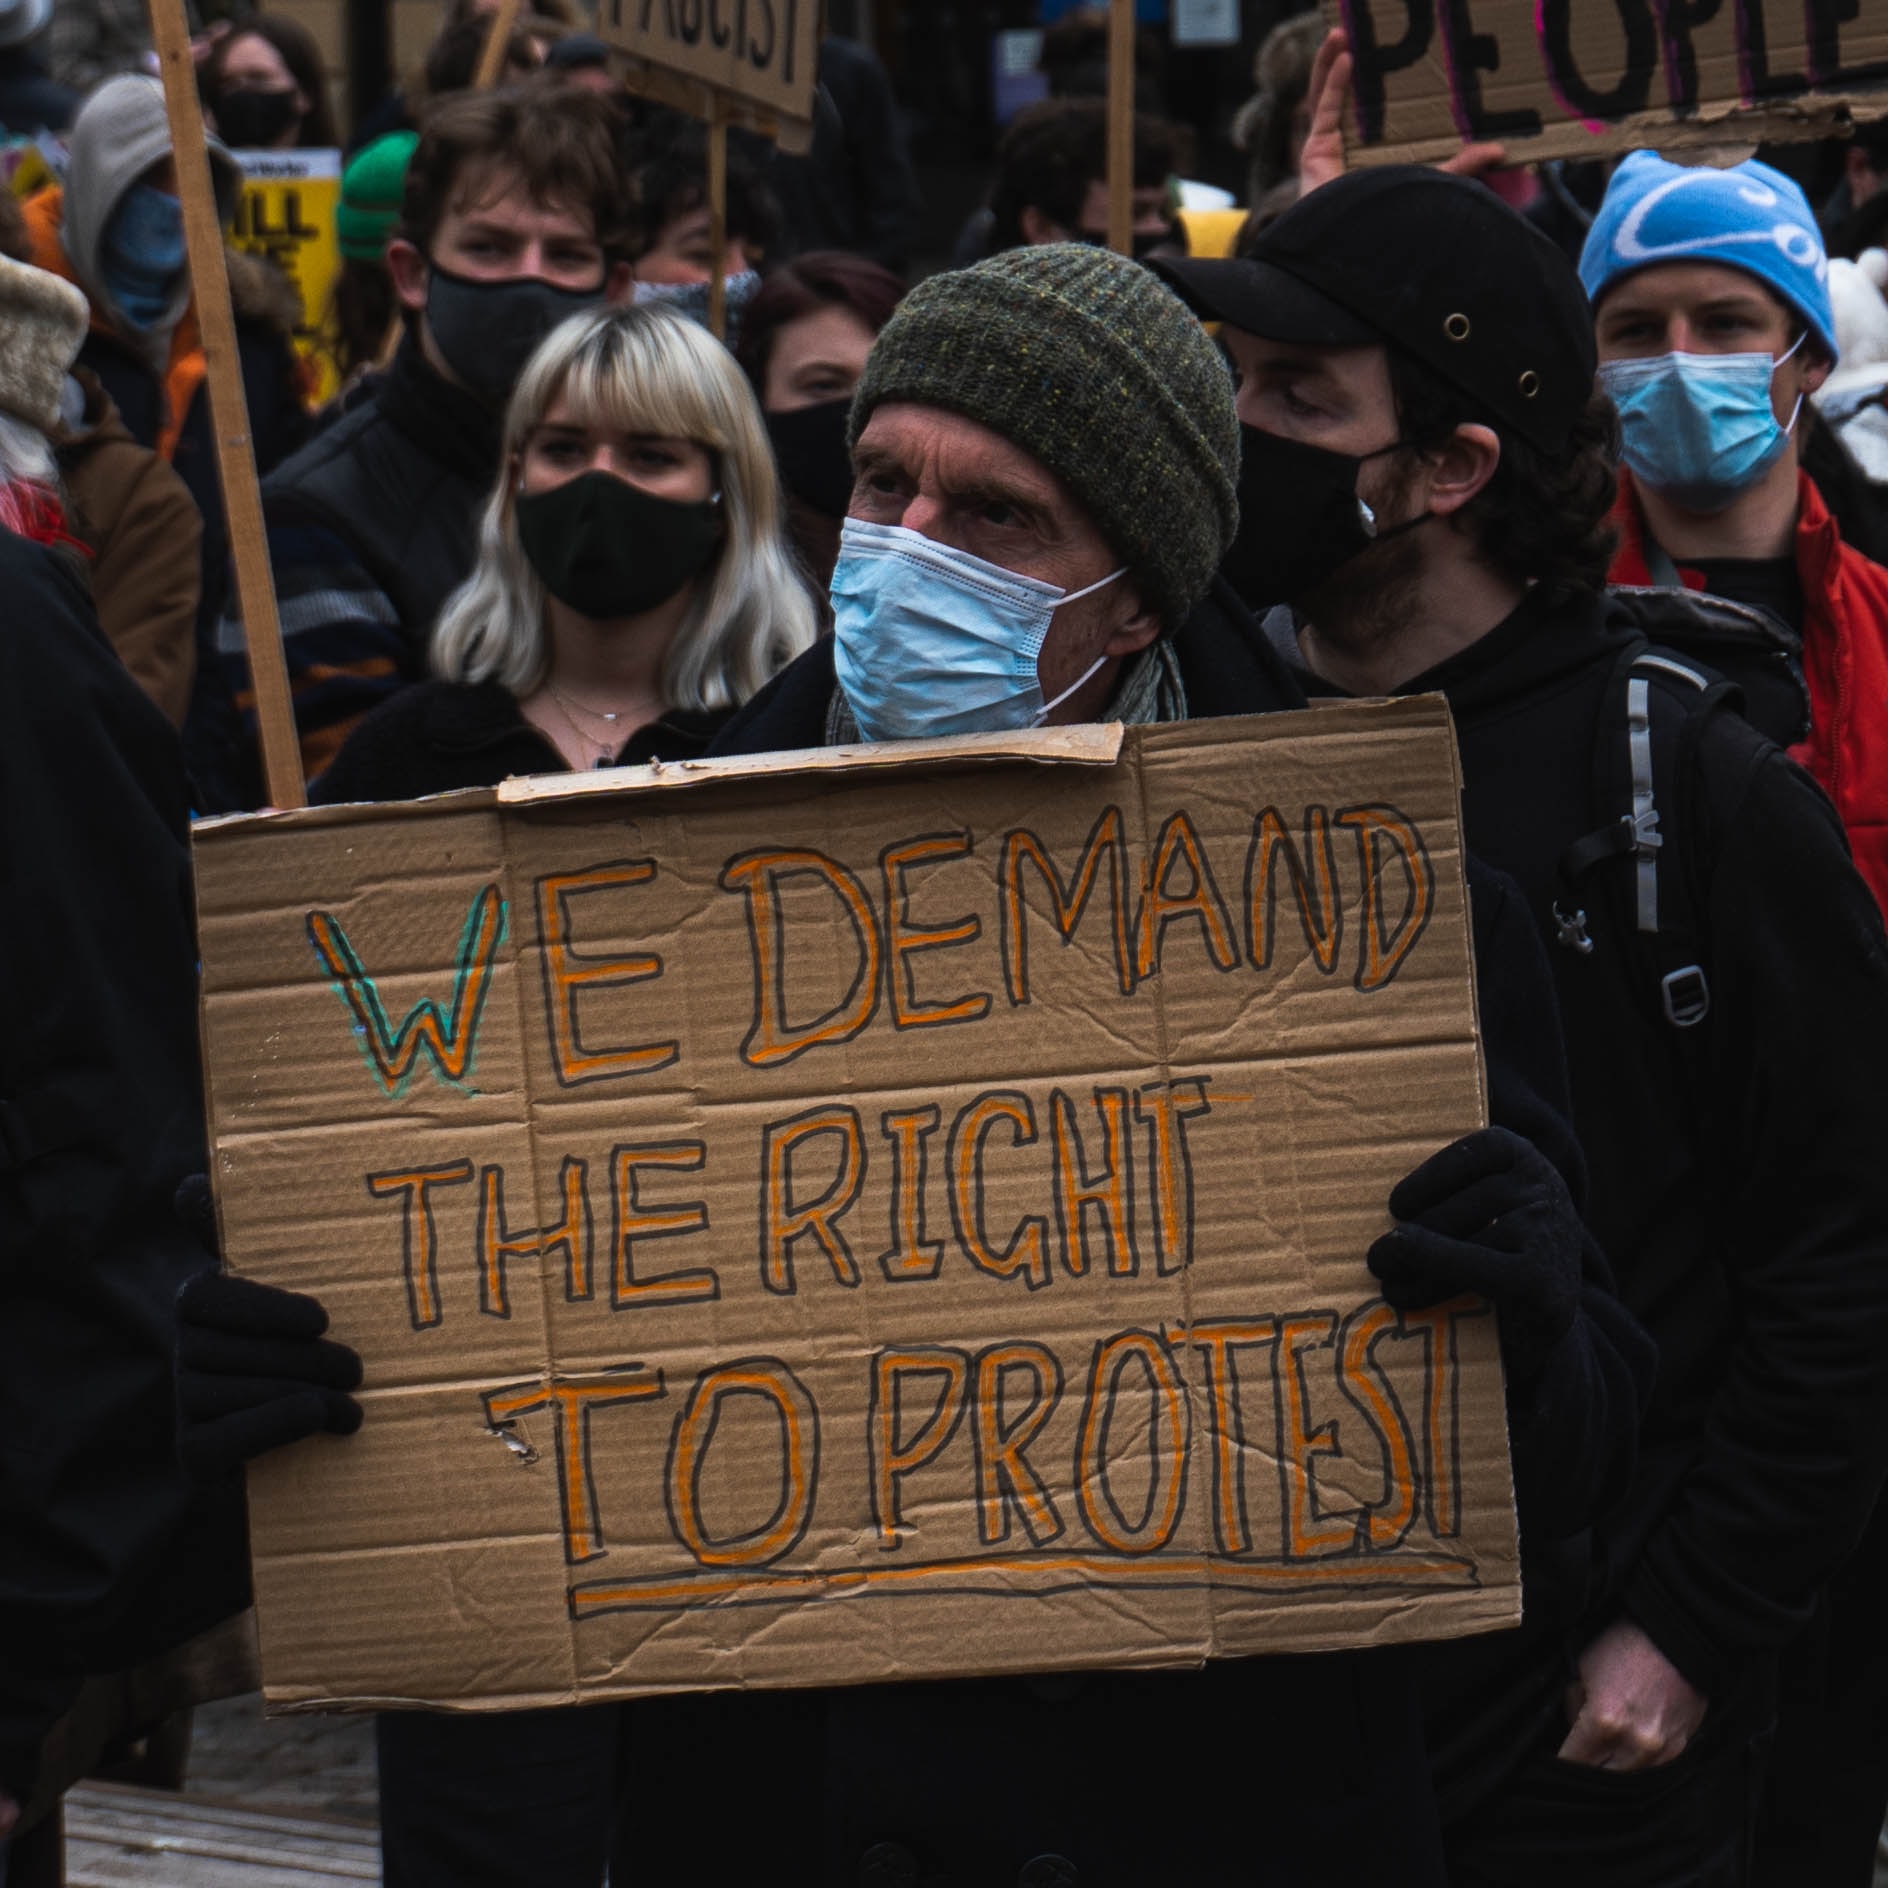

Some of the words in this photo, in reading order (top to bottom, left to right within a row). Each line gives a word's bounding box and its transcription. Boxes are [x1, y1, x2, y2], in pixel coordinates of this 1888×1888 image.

[234, 192, 319, 239] ILL
[310, 858, 678, 1098] WE
[721, 805, 1434, 1069] DEMAND
[366, 1140, 719, 1329] THE
[761, 1076, 1214, 1294] RIGHT
[482, 1360, 820, 1568] TO
[869, 1296, 1490, 1558] PROTEST
